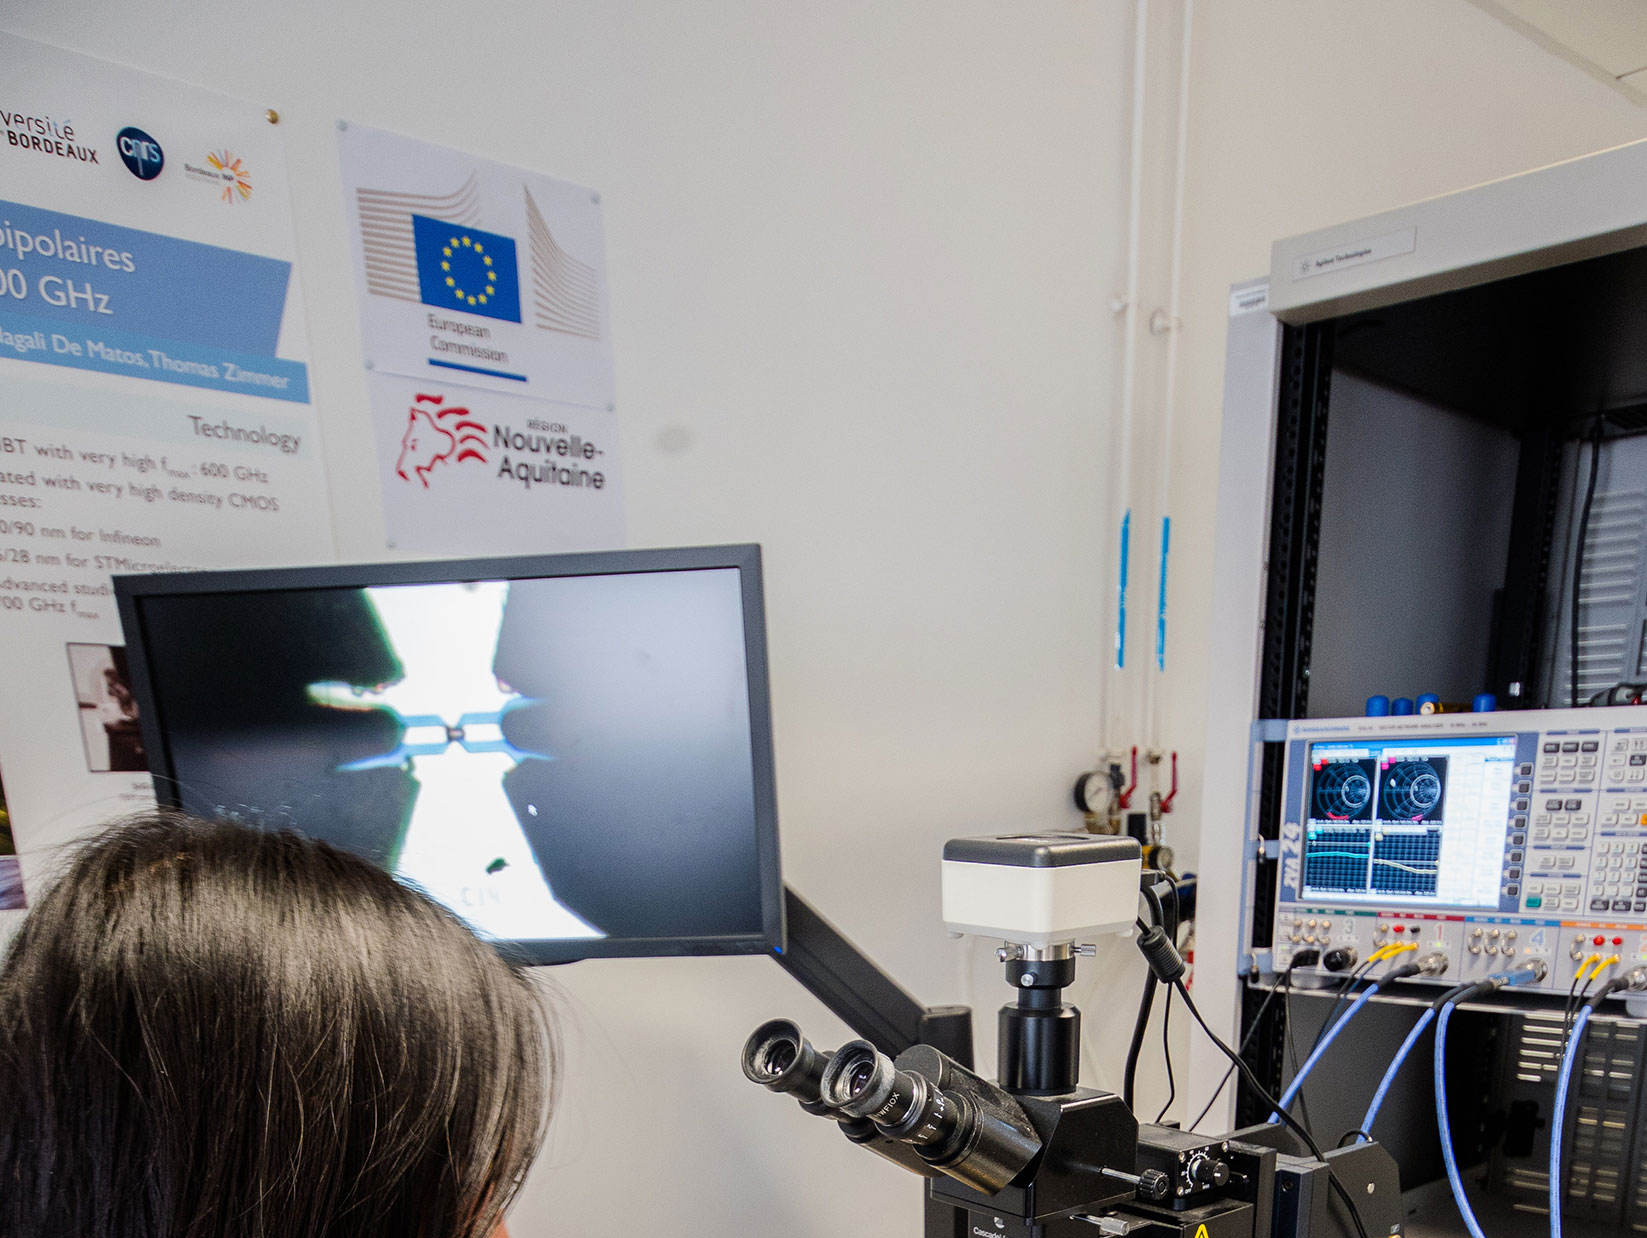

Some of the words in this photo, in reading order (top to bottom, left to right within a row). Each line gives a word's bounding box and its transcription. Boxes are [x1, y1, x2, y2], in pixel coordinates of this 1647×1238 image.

[7, 130, 99, 164] BORDEAUX
[39, 275, 113, 314] GHz
[427, 313, 492, 339] European
[0, 327, 46, 353] agali
[51, 334, 82, 356] De
[149, 350, 219, 379] Thomas
[222, 362, 291, 389] Zimmer
[430, 335, 509, 363] Commission
[188, 415, 301, 453] Technology
[494, 424, 604, 459] Nouvelle-
[0, 437, 27, 454] BT
[34, 445, 73, 460] with
[79, 450, 117, 470] very
[122, 452, 157, 474] high
[200, 462, 230, 478] 600
[233, 465, 269, 483] GHz
[498, 456, 606, 490] Aquitaine
[42, 474, 81, 490] with
[85, 481, 123, 499] very
[129, 481, 163, 503] high
[168, 487, 222, 509] density
[228, 492, 280, 512] CMOS
[40, 527, 66, 538] nm
[70, 526, 95, 541] for
[98, 528, 161, 546] Infineon
[36, 555, 61, 566] nm
[65, 553, 90, 567] for
[0, 595, 24, 610] 00
[29, 597, 66, 613] GHz
[1532, 929, 1544, 944] 4
